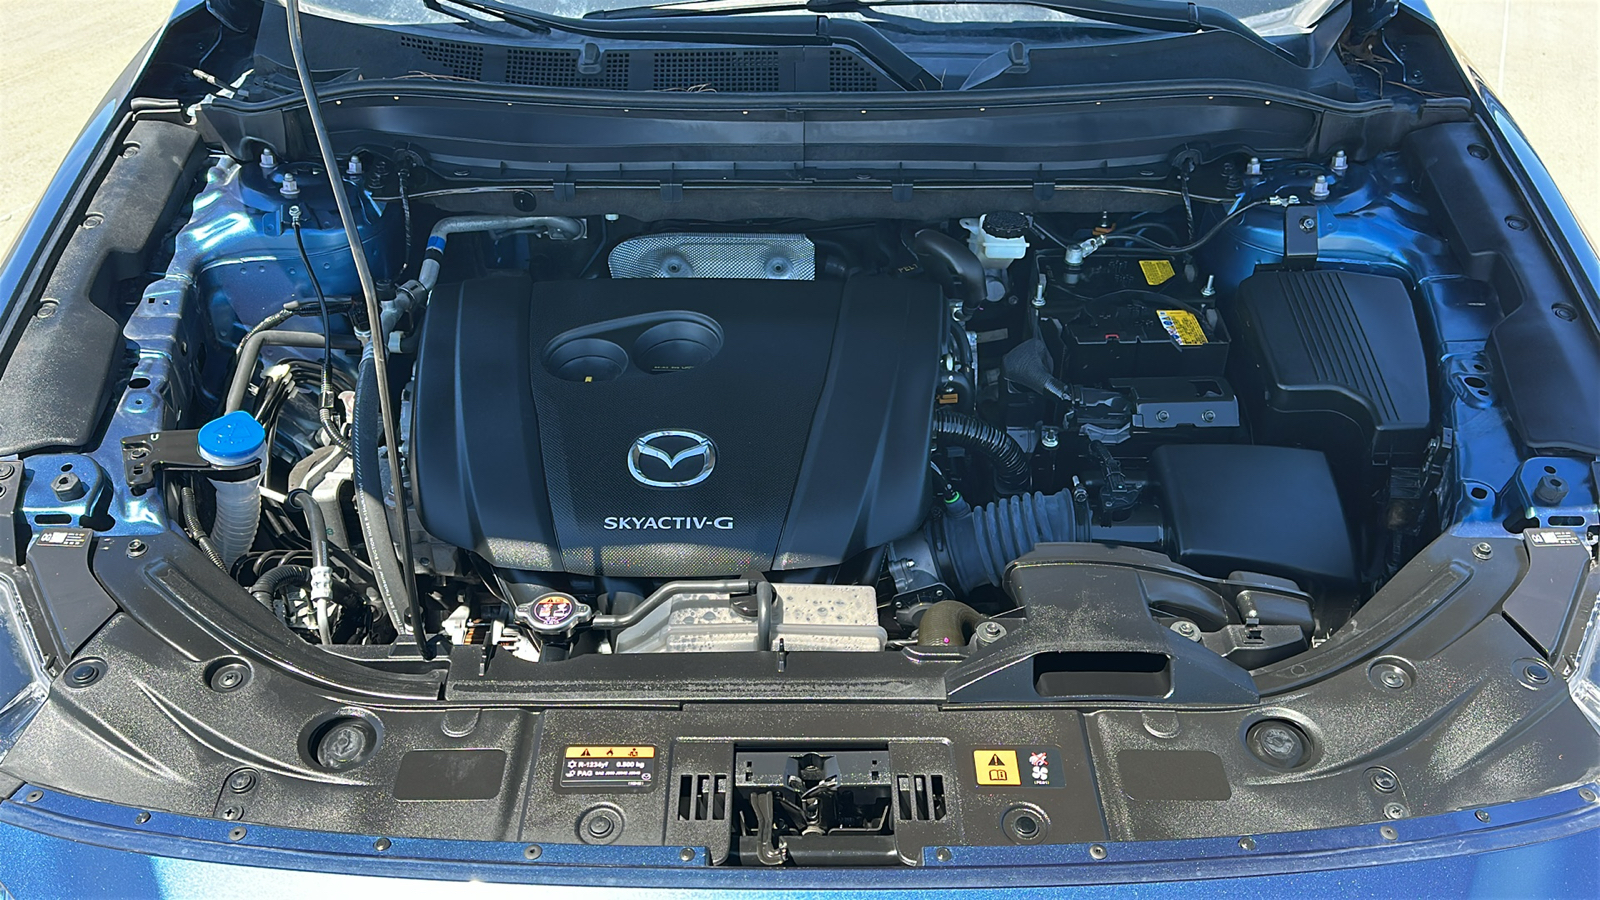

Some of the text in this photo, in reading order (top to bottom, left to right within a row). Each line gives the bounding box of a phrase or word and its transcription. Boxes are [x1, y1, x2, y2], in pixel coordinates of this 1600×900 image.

[603, 516, 734, 530] SKYACTIV-G
[369, 537, 379, 560] SUCTION
[578, 761, 609, 769] R-1234yf
[635, 761, 645, 769] kg
